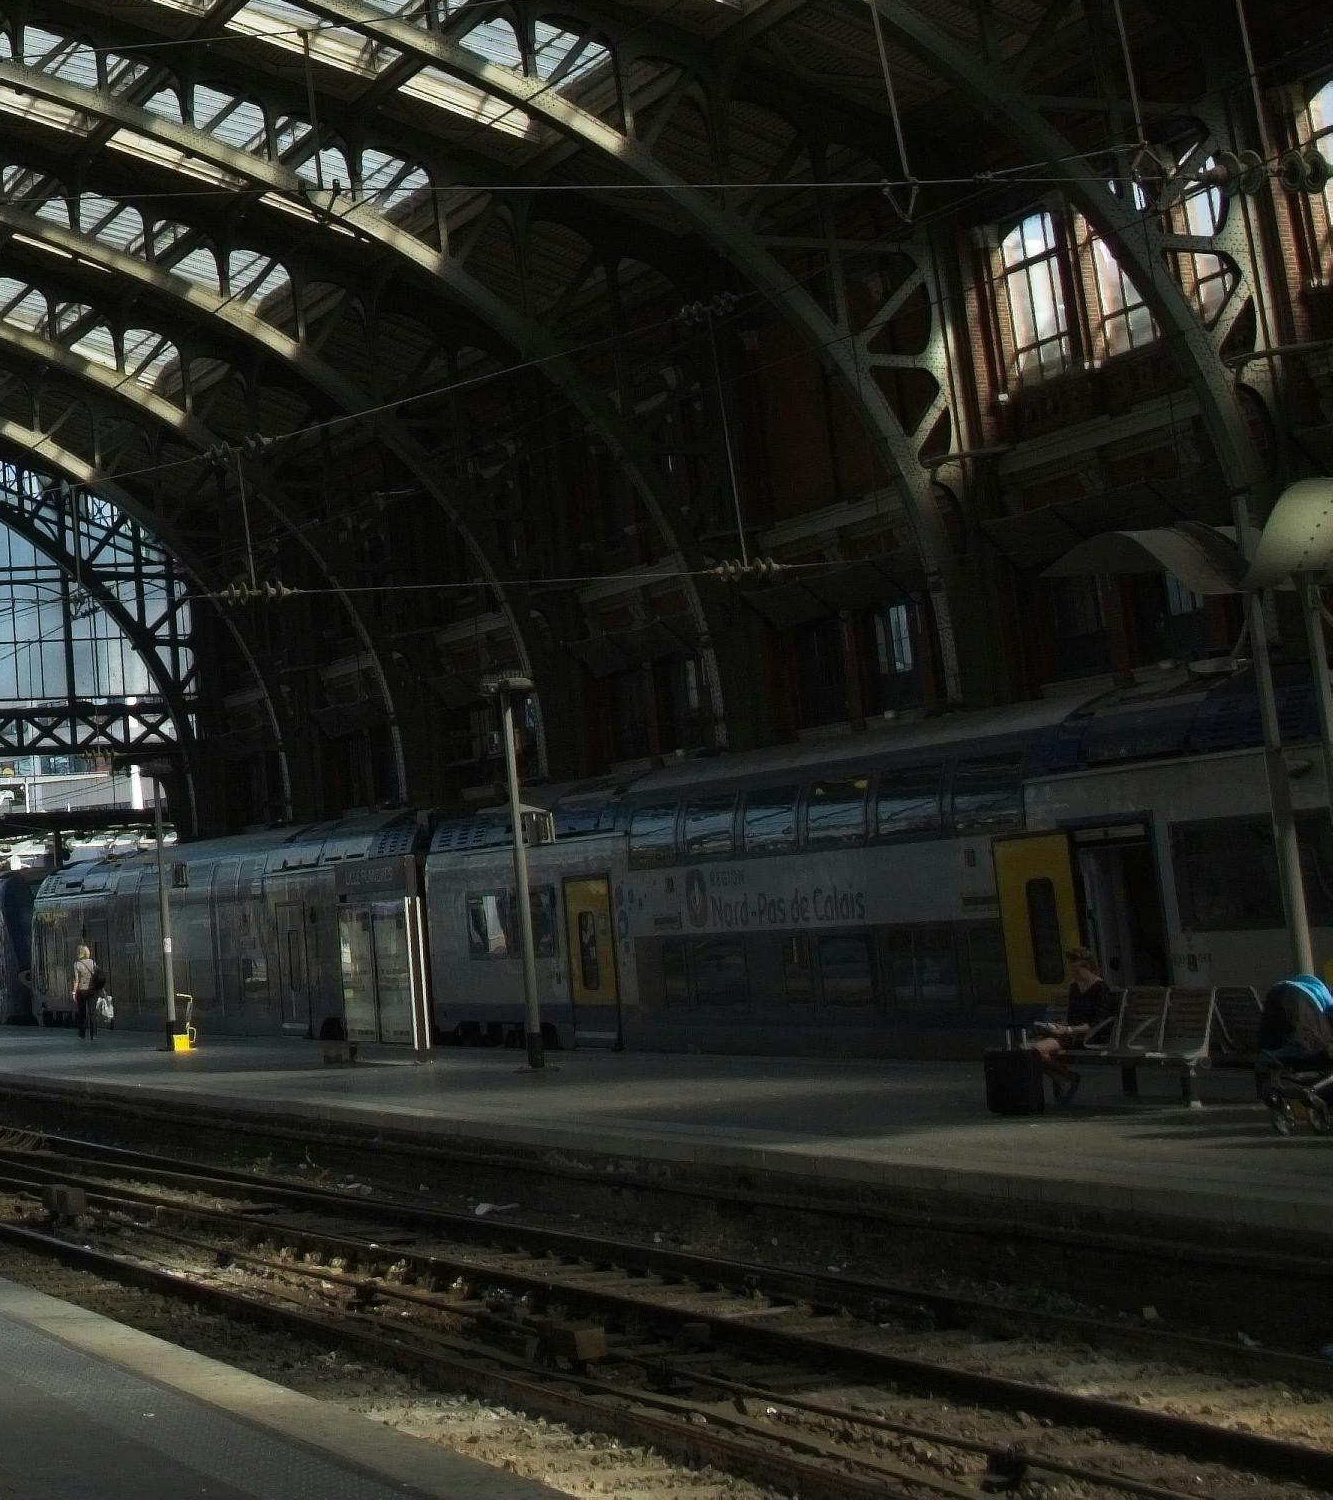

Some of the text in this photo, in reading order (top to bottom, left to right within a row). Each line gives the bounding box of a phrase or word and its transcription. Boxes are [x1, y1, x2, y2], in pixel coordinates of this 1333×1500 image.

[711, 884, 865, 928] Nord-Pas de Calais
